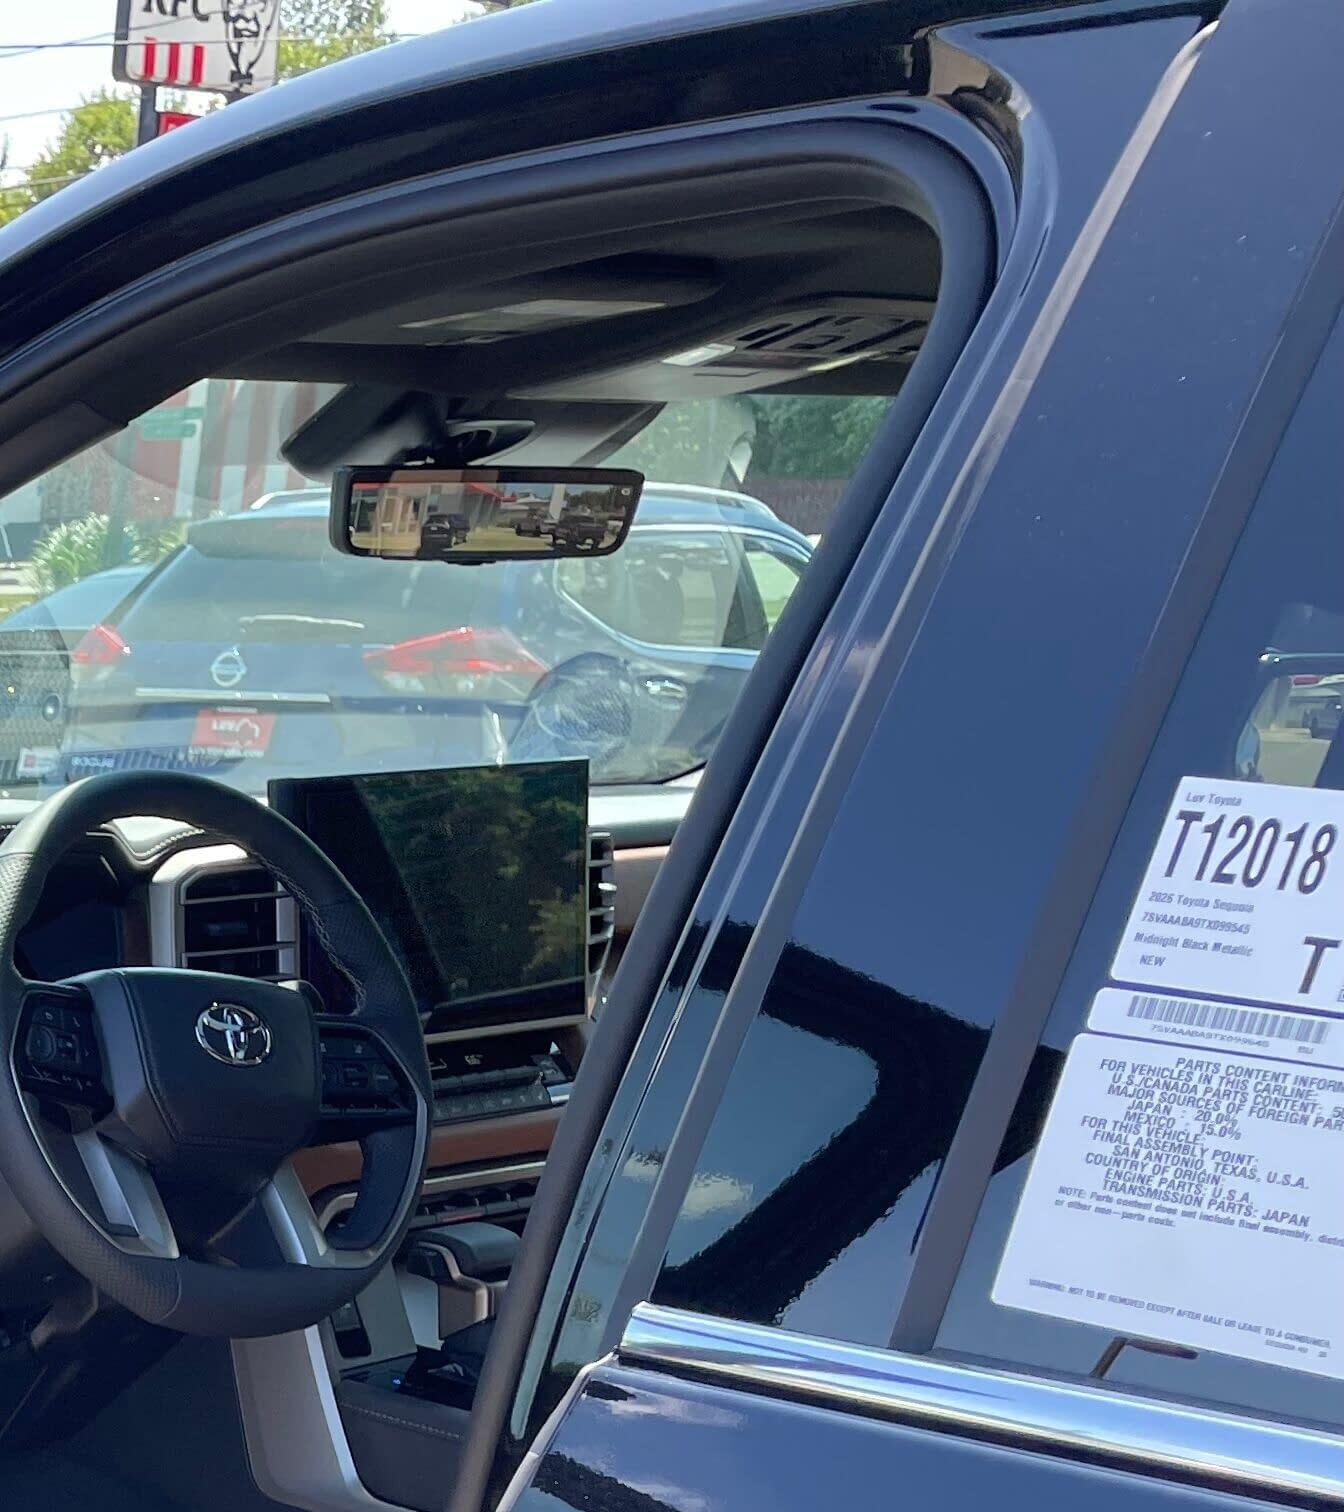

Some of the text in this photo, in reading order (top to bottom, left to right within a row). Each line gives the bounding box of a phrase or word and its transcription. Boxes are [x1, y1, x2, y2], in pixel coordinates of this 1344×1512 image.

[1208, 794, 1242, 807] Toyota
[1164, 810, 1338, 895] T12018
[1177, 894, 1210, 908] Toyota
[1213, 898, 1255, 914] Sequoia
[1133, 932, 1254, 957] Midnight Black Metallic
[1139, 954, 1166, 967] NEW
[1298, 936, 1343, 995] T
[1100, 1058, 1319, 1100] FOR VEHICLES IN THIS CARLINE:
[1175, 1057, 1221, 1074] PARTS
[1225, 1064, 1289, 1084] CONTENT
[1107, 1083, 1344, 1131] MAJOR SOURCES OF FOREIGN PAR
[1112, 1073, 1198, 1096] U.S./CANADA
[1202, 1086, 1249, 1103] PARTS
[1253, 1094, 1324, 1115] CONTENT:
[1081, 1115, 1207, 1145] FOR THIS VEHICLE:
[1124, 1111, 1176, 1129] MEXICO
[1200, 1123, 1242, 1141] 15.0%
[1127, 1100, 1173, 1116] JAPAN
[1194, 1109, 1238, 1127] 20.0%
[1092, 1129, 1259, 1166] FINAL ASSEMBLY POINT:
[1085, 1152, 1224, 1186] COUNTRY OF ORIGIN:
[1112, 1145, 1310, 1190] SAN ANTONIO, TEXAS, U.S.A.
[1102, 1179, 1311, 1228] TRANSMISSION PARTS: JAPAN
[1105, 1168, 1254, 1205] ENGINE PARTS: U.S.A.
[1058, 1186, 1087, 1199] NOTE:
[1089, 1192, 1114, 1204] Parts
[1116, 1197, 1152, 1211] content
[1154, 1203, 1178, 1216] does
[1181, 1208, 1196, 1219] not
[1199, 1212, 1235, 1226] include
[1238, 1219, 1260, 1232] final
[1263, 1225, 1313, 1242] assembly,
[1067, 1200, 1092, 1212] other
[1068, 1286, 1084, 1296] NOT
[1085, 1289, 1095, 1298] TO
[1096, 1291, 1107, 1301] BE
[1108, 1294, 1145, 1309] REMOVED
[1147, 1302, 1175, 1315] EXCEPT
[1176, 1309, 1201, 1321] AFTER
[1203, 1314, 1224, 1326] SALE
[1224, 1318, 1237, 1328] OR
[1238, 1321, 1262, 1335] LEASE
[1265, 1327, 1275, 1338] TO
[1275, 1330, 1283, 1339] A
